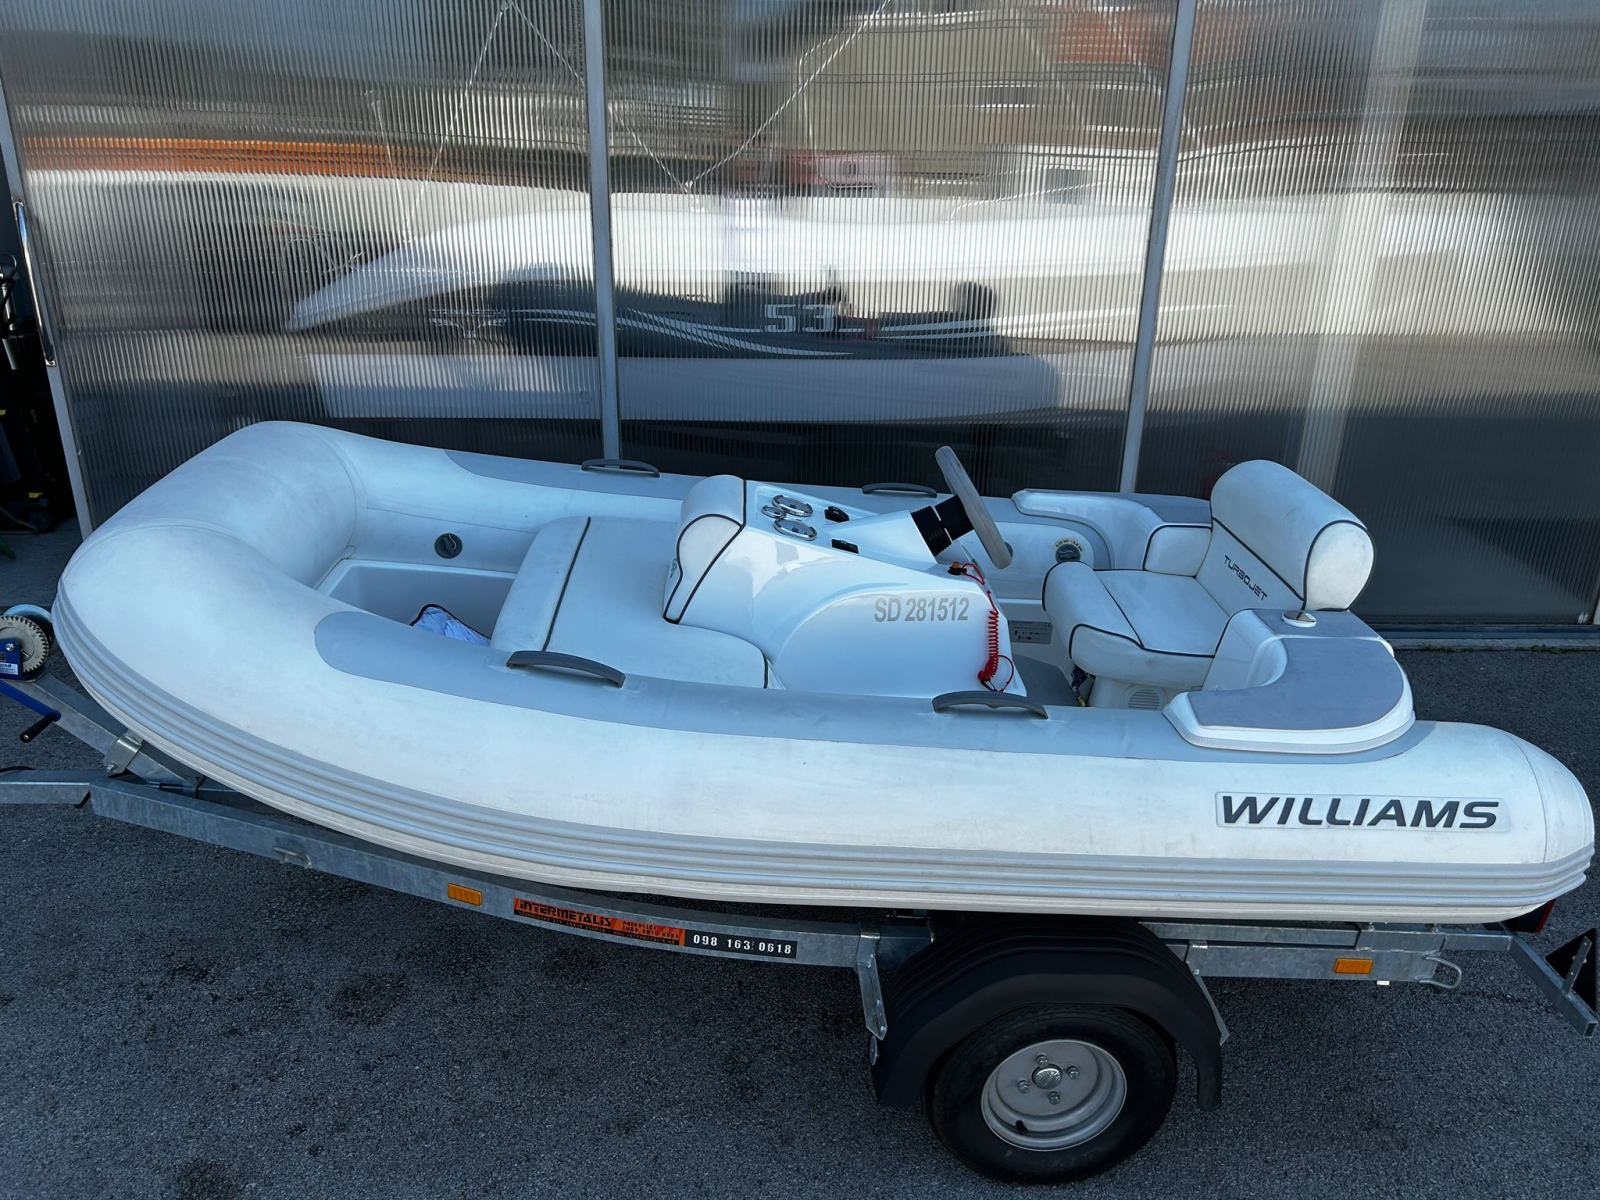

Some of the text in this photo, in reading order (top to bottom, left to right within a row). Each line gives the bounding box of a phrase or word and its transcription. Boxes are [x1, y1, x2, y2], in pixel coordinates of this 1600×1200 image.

[1224, 554, 1268, 601] TURBOJET
[874, 597, 969, 622] SD 281512
[1222, 795, 1499, 829] WILLIAMS
[693, 934, 718, 946] 098
[727, 939, 751, 950] 163
[758, 942, 792, 954] 0618
